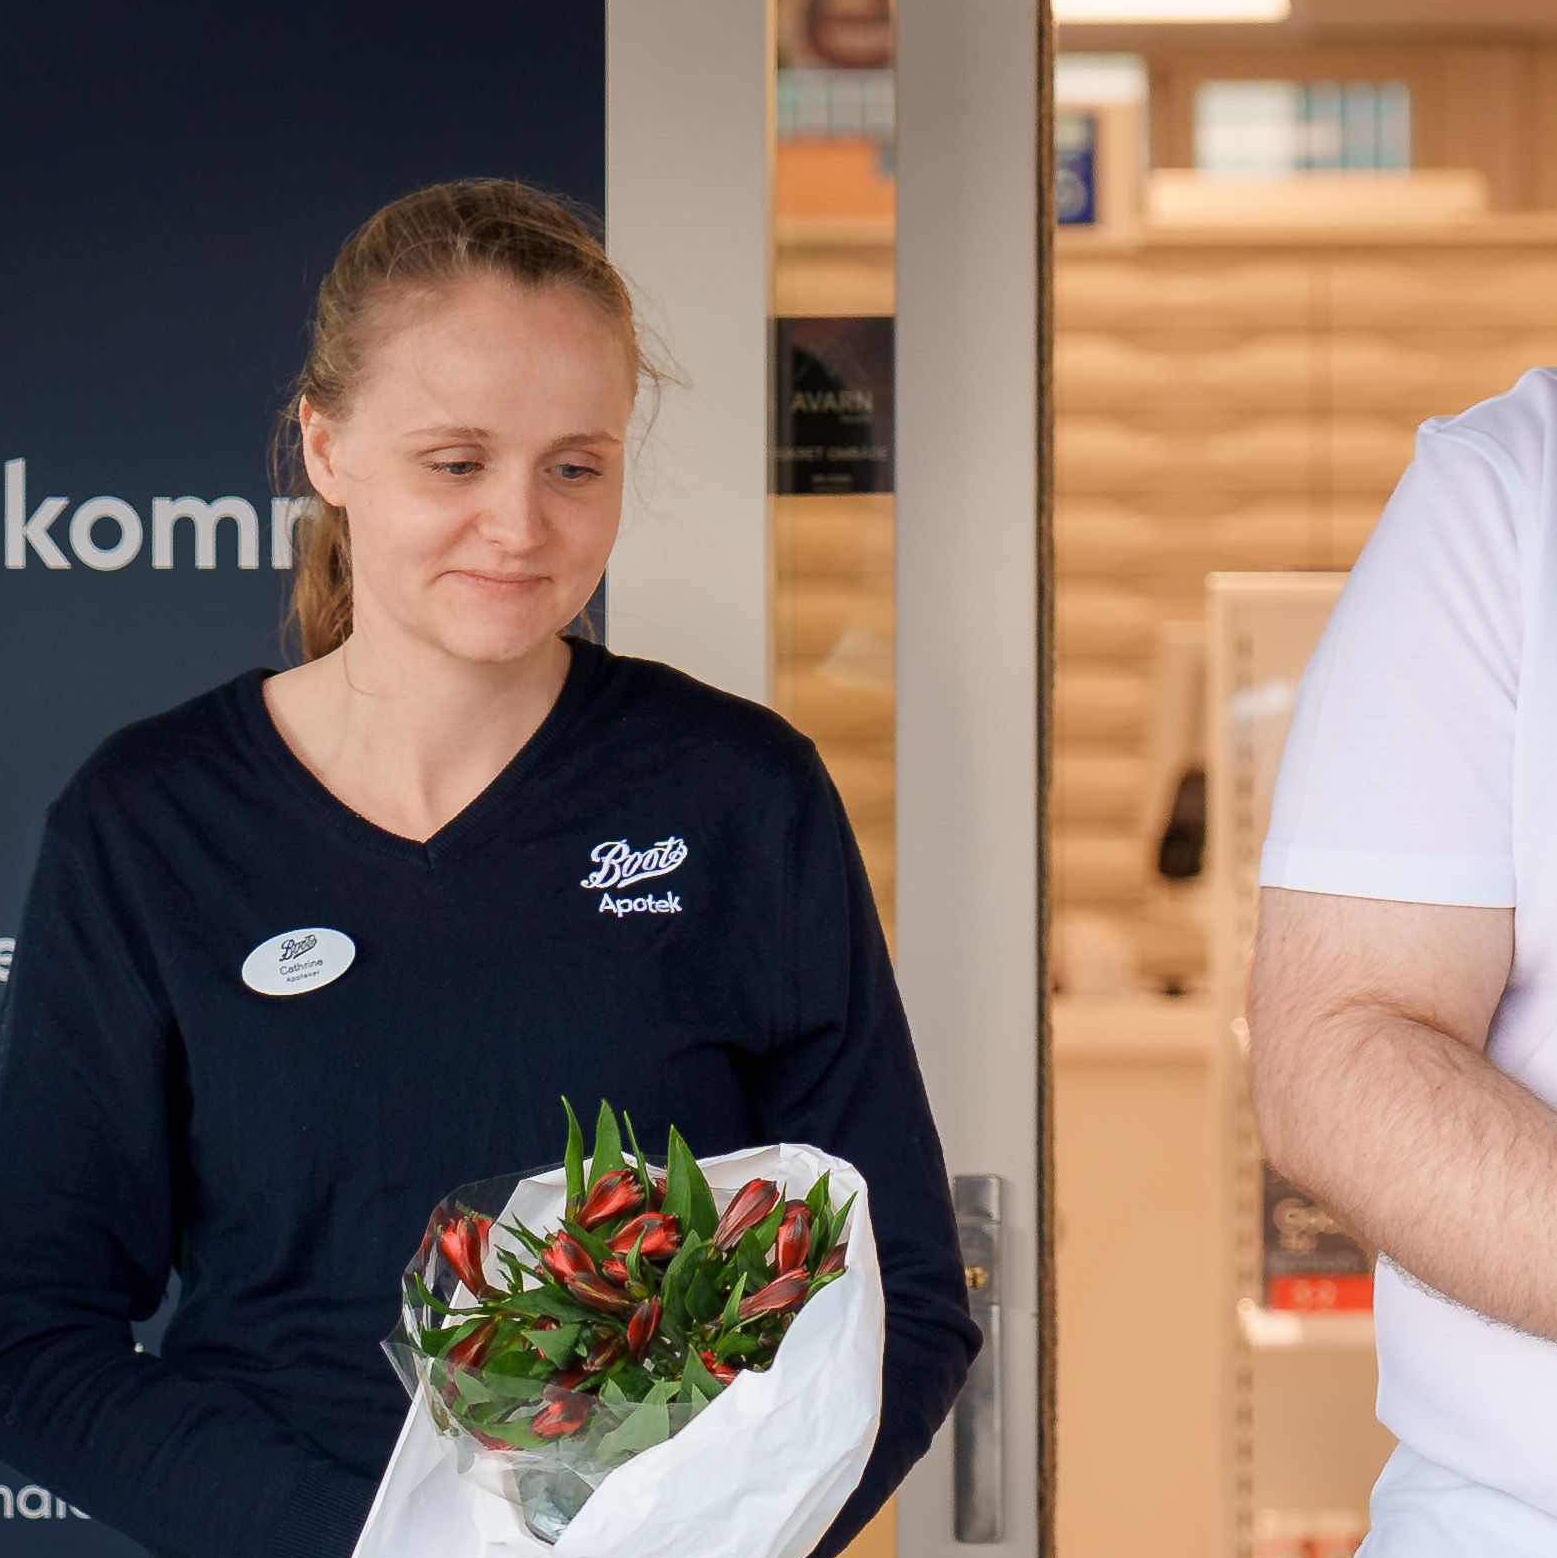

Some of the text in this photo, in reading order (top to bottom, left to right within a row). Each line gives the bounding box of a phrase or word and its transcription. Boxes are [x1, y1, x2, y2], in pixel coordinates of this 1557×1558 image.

[580, 835, 689, 889] Boots
[598, 891, 683, 918] Apotek
[279, 933, 318, 962] Boots
[279, 958, 324, 976] Cathrine
